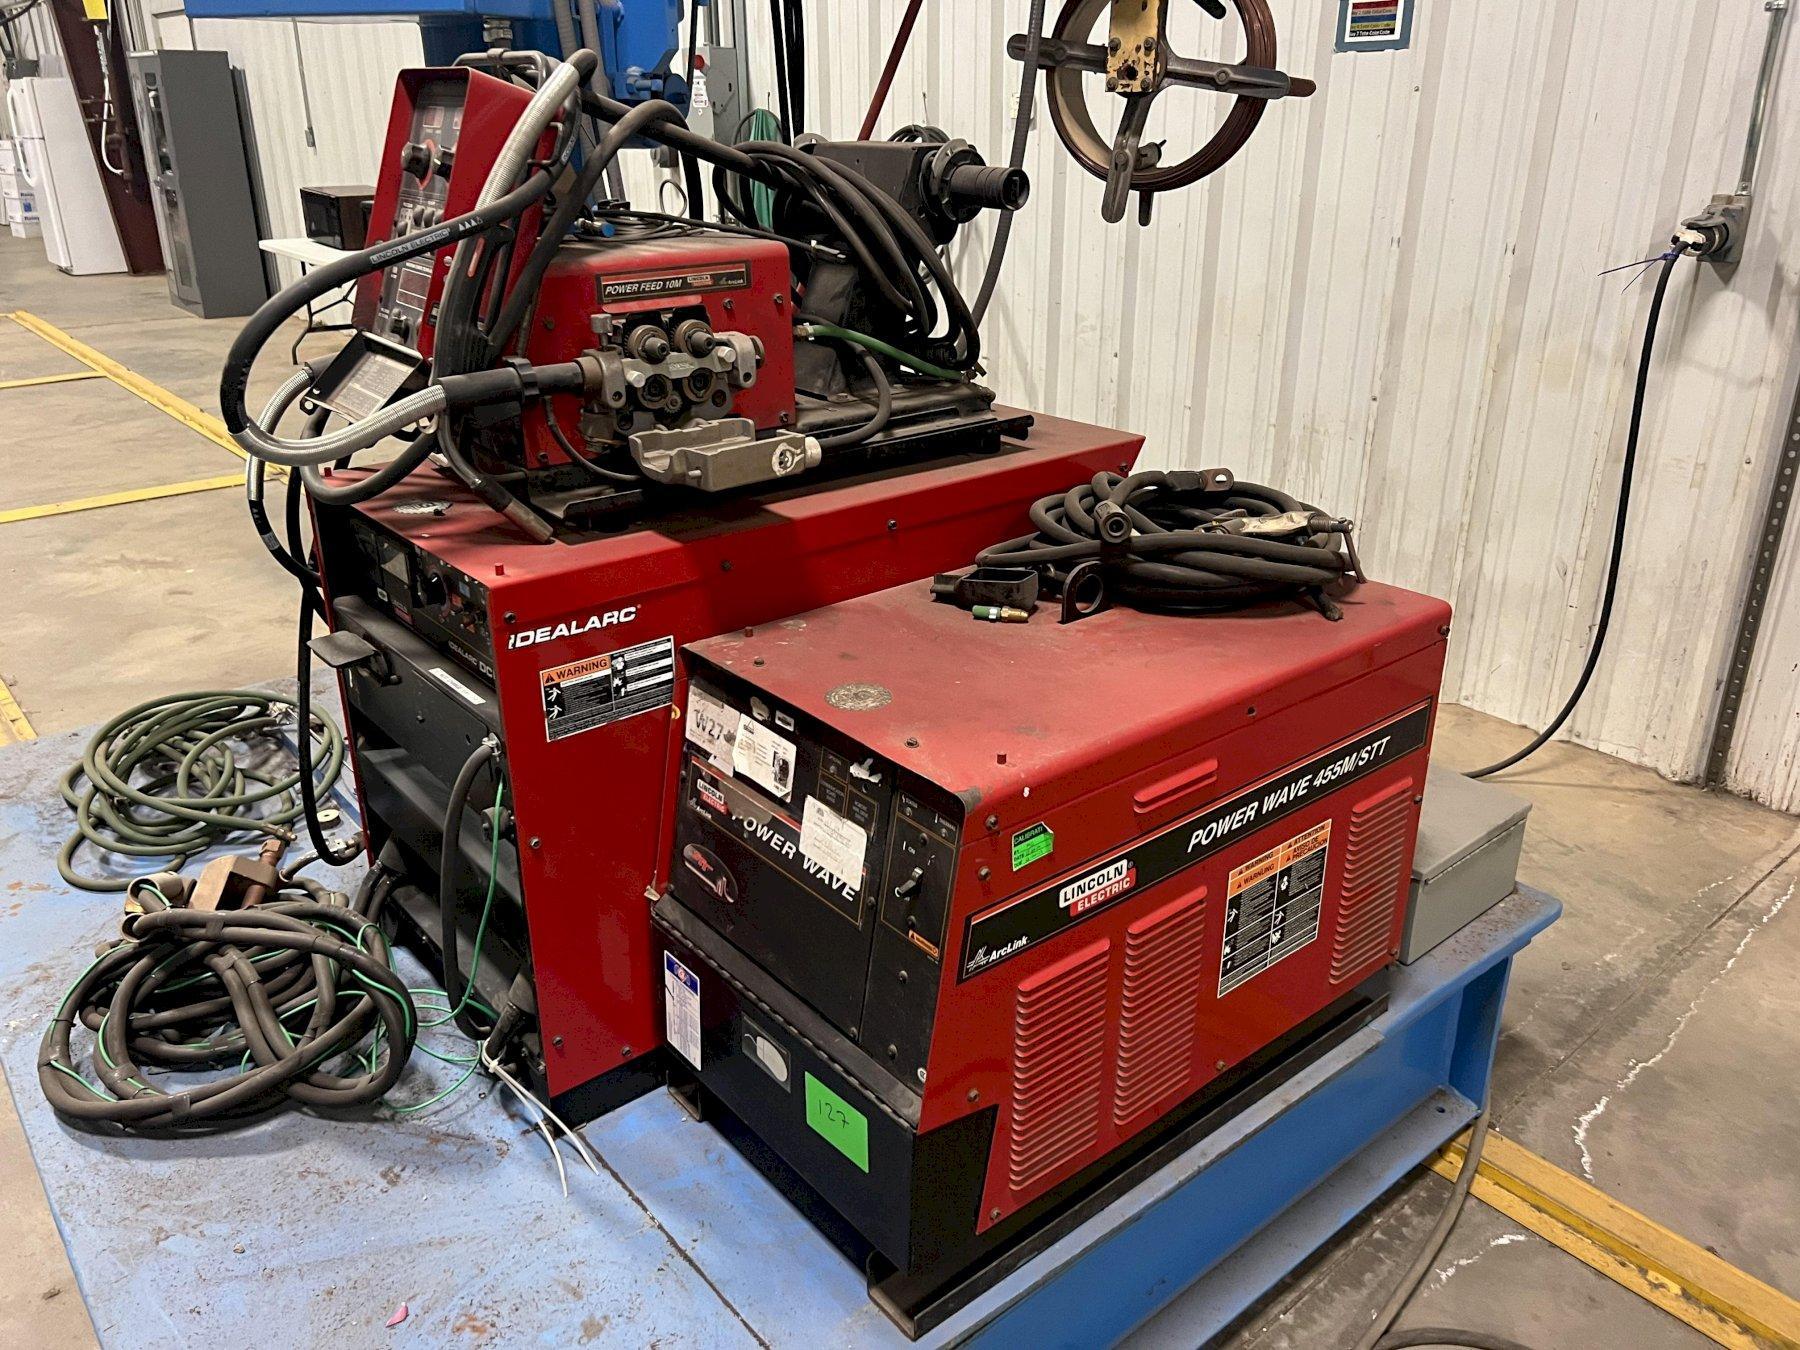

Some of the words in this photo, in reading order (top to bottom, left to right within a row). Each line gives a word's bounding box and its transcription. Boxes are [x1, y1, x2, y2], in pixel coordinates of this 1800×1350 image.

[371, 245, 409, 263] LINCOLN
[410, 231, 448, 250] ELECTRIC
[605, 282, 638, 295] POWER
[639, 281, 663, 292] FEED
[665, 279, 683, 289] 10M
[508, 606, 637, 649] IDEALARC
[556, 658, 609, 680] WARNING
[1187, 801, 1258, 853] POWER
[1262, 774, 1313, 815] WAVE
[1313, 736, 1391, 788] 455M/STT
[732, 815, 797, 860] OWER
[1243, 863, 1275, 885] WARNING
[1245, 852, 1274, 871] WARNING
[1063, 864, 1124, 903] LINCOLN
[1077, 877, 1130, 912] ELECTRIC
[989, 935, 1029, 963] ArcLink
[817, 1099, 850, 1129] 127
